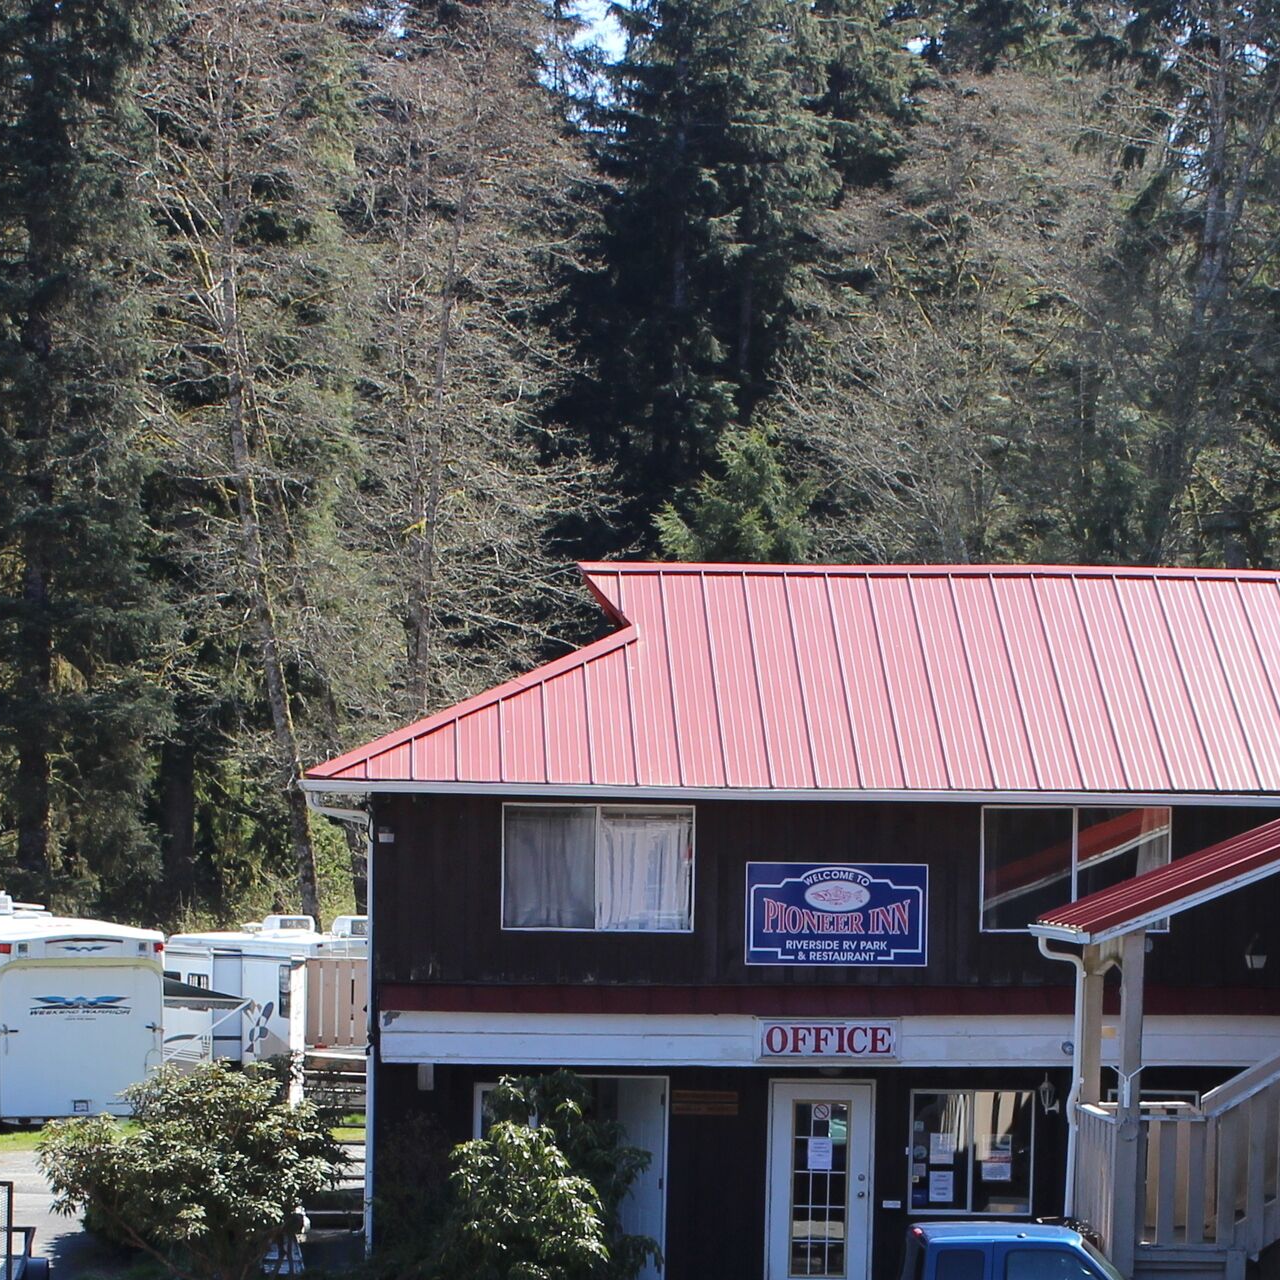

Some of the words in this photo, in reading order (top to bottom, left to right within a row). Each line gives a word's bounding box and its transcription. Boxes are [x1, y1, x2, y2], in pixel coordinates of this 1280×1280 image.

[803, 871, 855, 886] WELCOME
[856, 875, 870, 887] TO
[762, 897, 865, 934] PIONEER
[868, 899, 911, 935] INN
[785, 940, 840, 950] RIVERSIDE
[842, 940, 857, 950] RV
[860, 941, 888, 950] PARK
[797, 951, 806, 961] &
[809, 951, 875, 961] RESTAURANT
[765, 1025, 892, 1054] OFFICE
